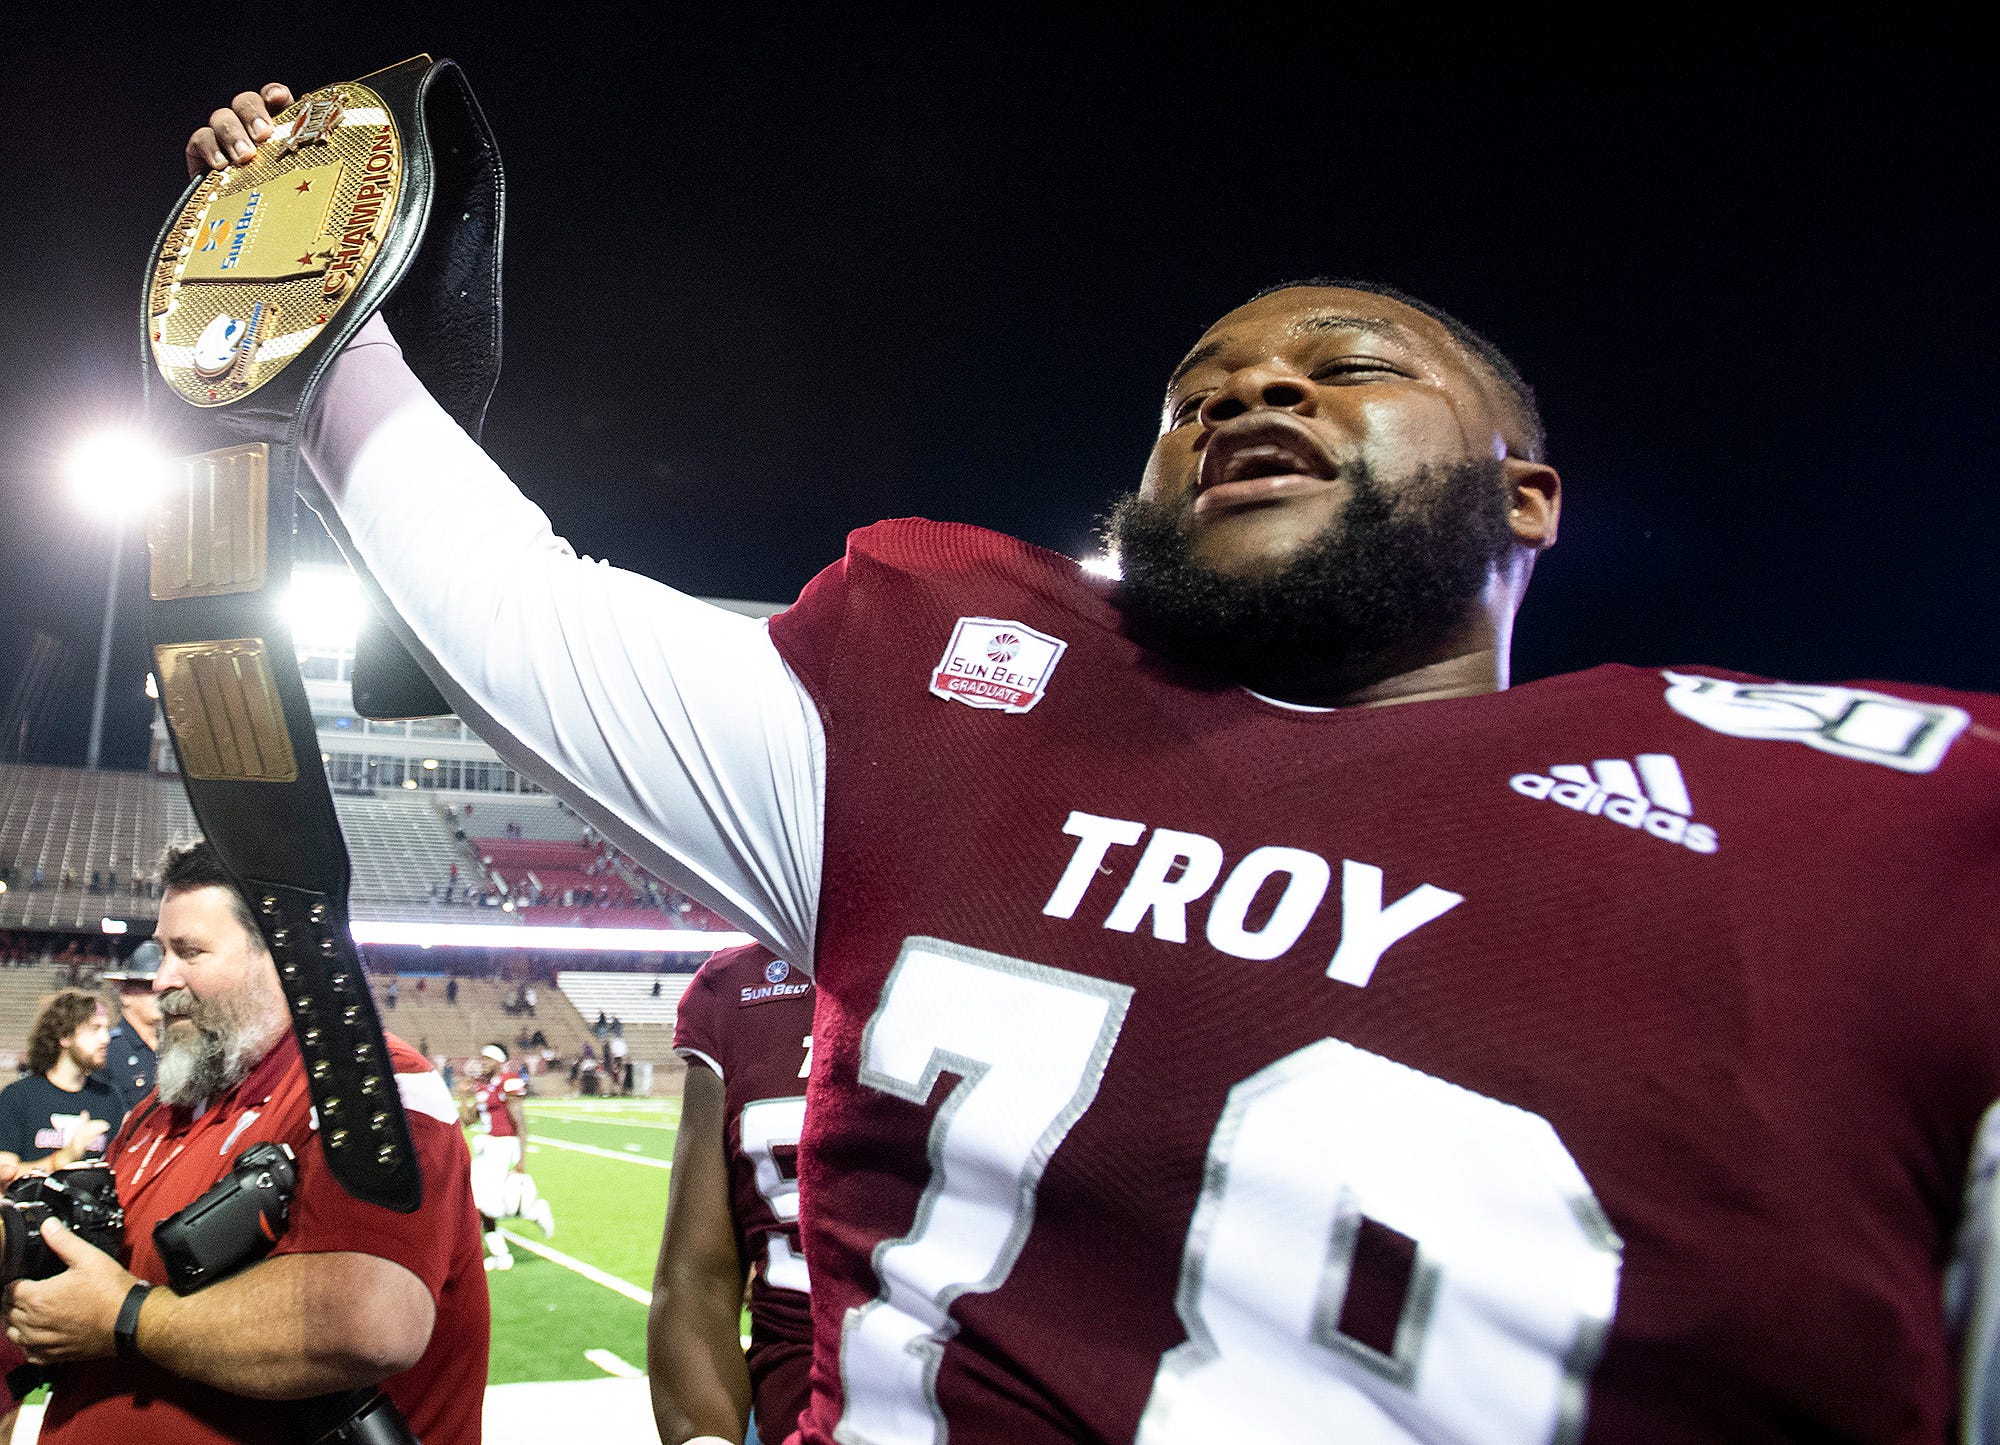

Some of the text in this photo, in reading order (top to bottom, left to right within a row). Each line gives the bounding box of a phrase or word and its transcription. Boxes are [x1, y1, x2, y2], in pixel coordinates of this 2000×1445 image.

[220, 232, 246, 270] SUN
[235, 192, 261, 231] BELT
[322, 133, 391, 296] CHAMPION
[948, 678, 1022, 703] GRADUATE
[950, 657, 1037, 688] SUN BELT
[1508, 772, 1720, 854] adidas
[1042, 810, 1465, 988] TROY
[741, 983, 809, 1002] SUN BELT
[833, 935, 1625, 1445] 78
